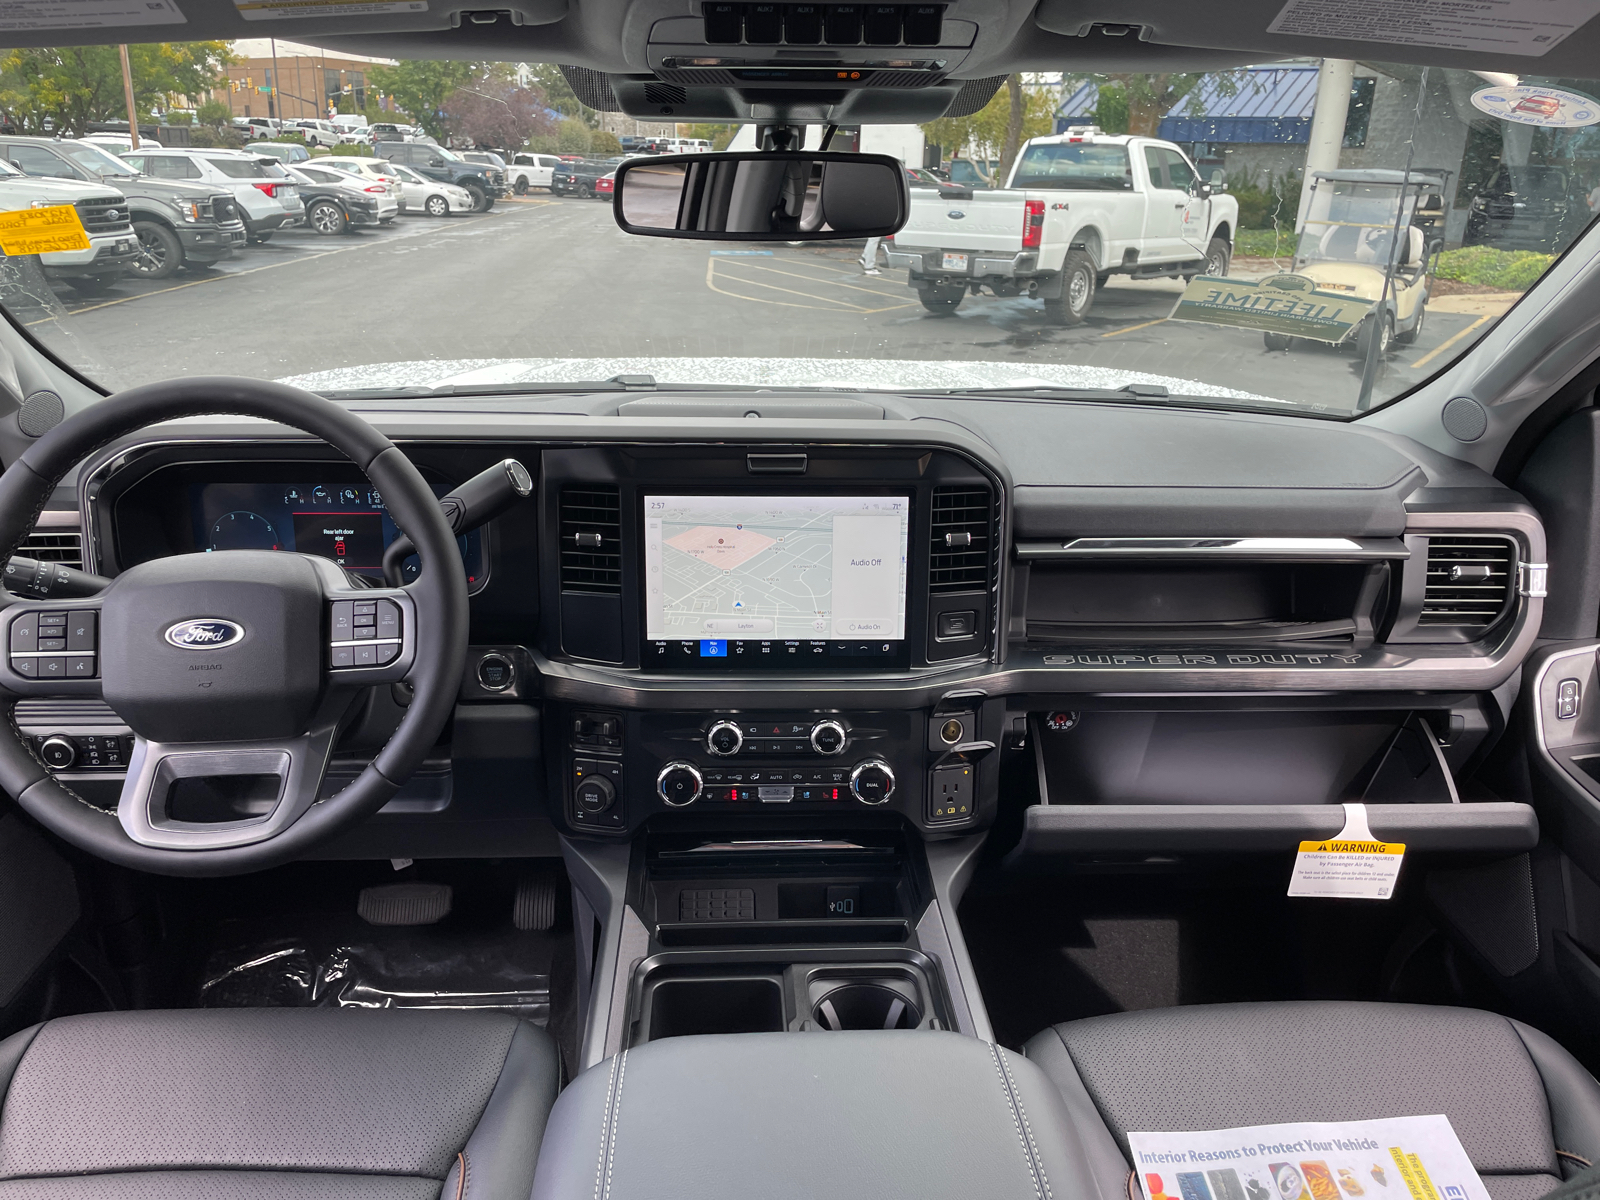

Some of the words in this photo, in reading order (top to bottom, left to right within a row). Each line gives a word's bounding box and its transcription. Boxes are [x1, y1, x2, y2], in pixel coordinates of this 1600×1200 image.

[871, 558, 882, 566] Off
[184, 625, 225, 642] Ford
[1042, 654, 1218, 666] SUPER
[1226, 653, 1363, 665] DUTY
[1331, 843, 1387, 853] WARNING
[1139, 1150, 1187, 1164] Interior
[1189, 1146, 1240, 1162] Reasons
[1242, 1145, 1257, 1157] to
[1257, 1141, 1304, 1156] Protect
[1303, 1139, 1333, 1152] Your
[1333, 1137, 1380, 1152] Vehicle
[1408, 1153, 1419, 1169] The
[1390, 1146, 1411, 1178] Interior
[1407, 1179, 1421, 1196] and
